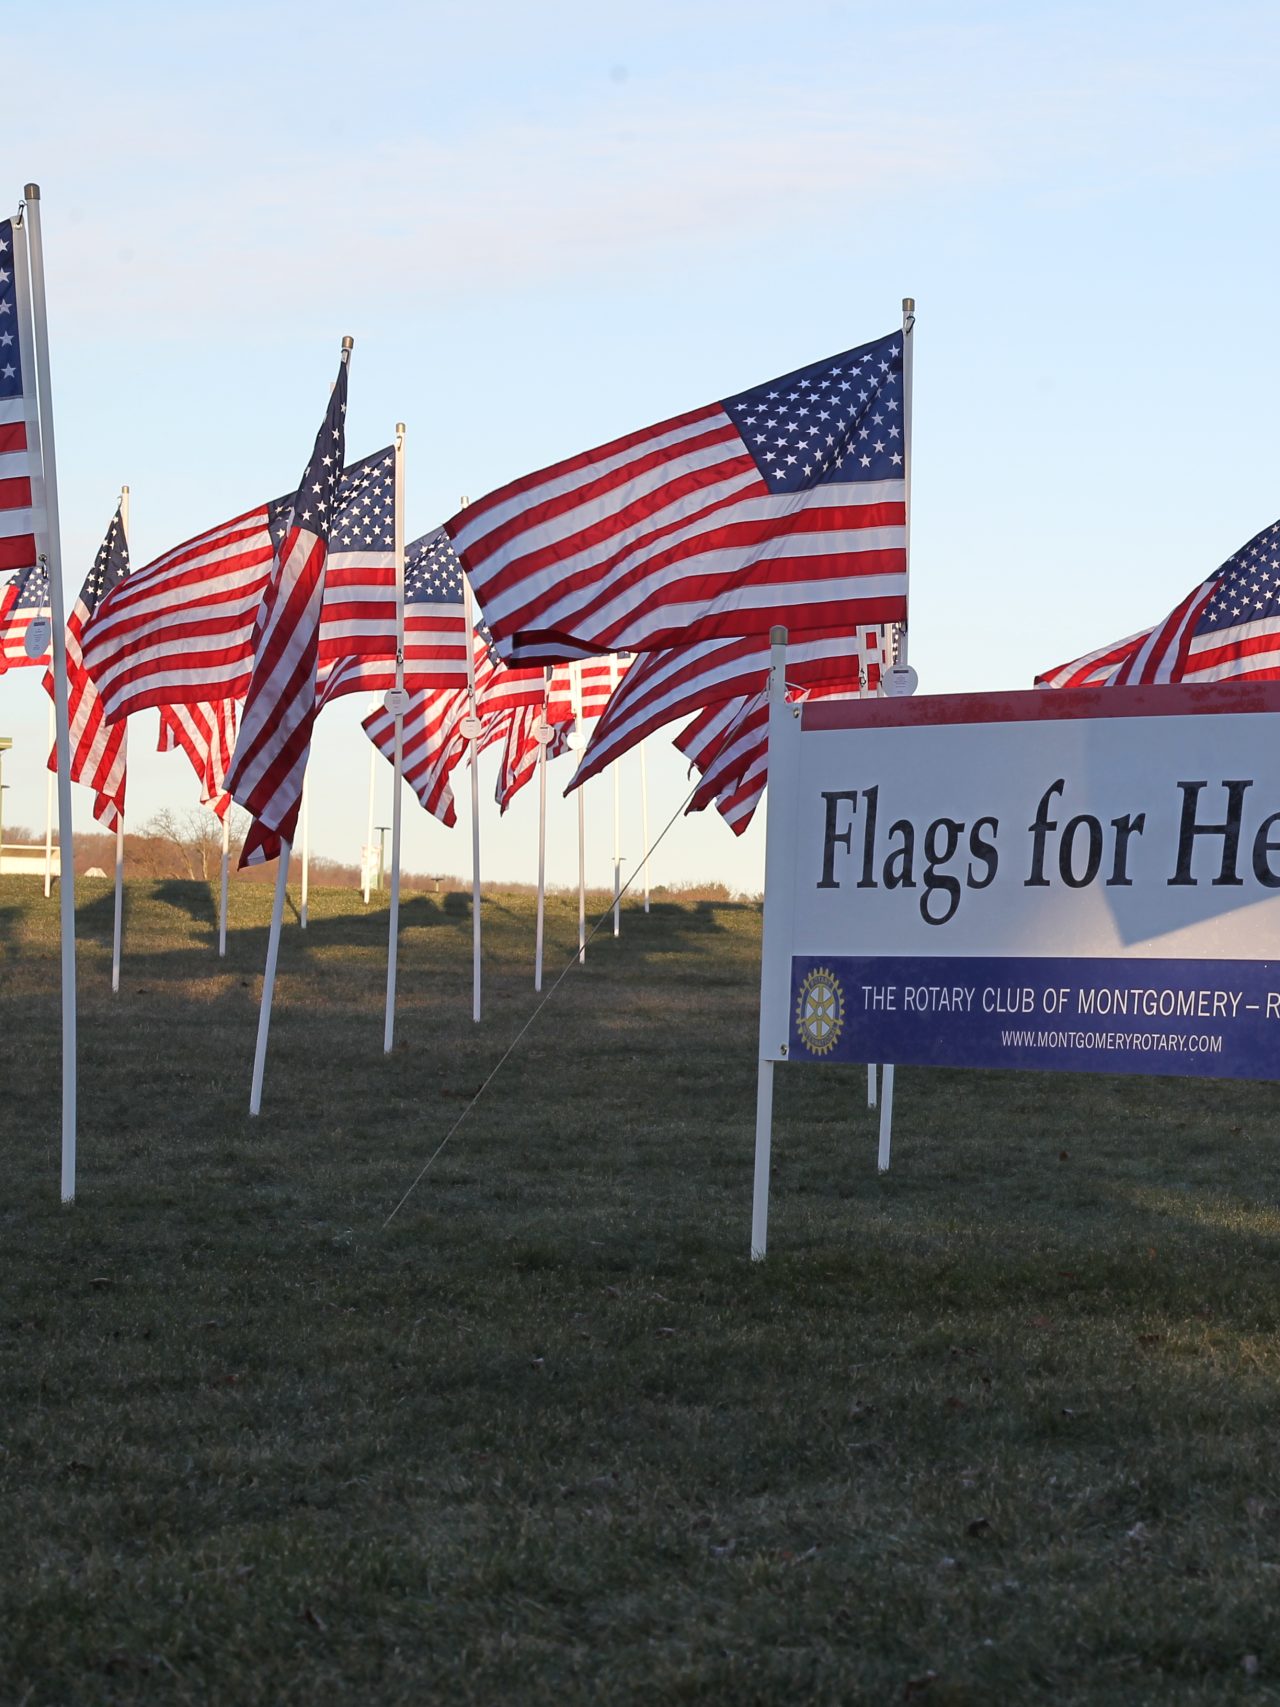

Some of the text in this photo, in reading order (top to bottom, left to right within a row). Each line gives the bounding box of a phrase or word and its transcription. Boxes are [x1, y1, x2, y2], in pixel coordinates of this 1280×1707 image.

[816, 784, 999, 926] Flags
[1023, 778, 1146, 889] for
[861, 986, 897, 1011] THE
[904, 986, 976, 1012] ROTARY
[982, 987, 1035, 1013] CLUB
[1042, 987, 1071, 1014] OF
[1001, 1030, 1223, 1053] WWW.MONTGOMERYROTARY.COM
